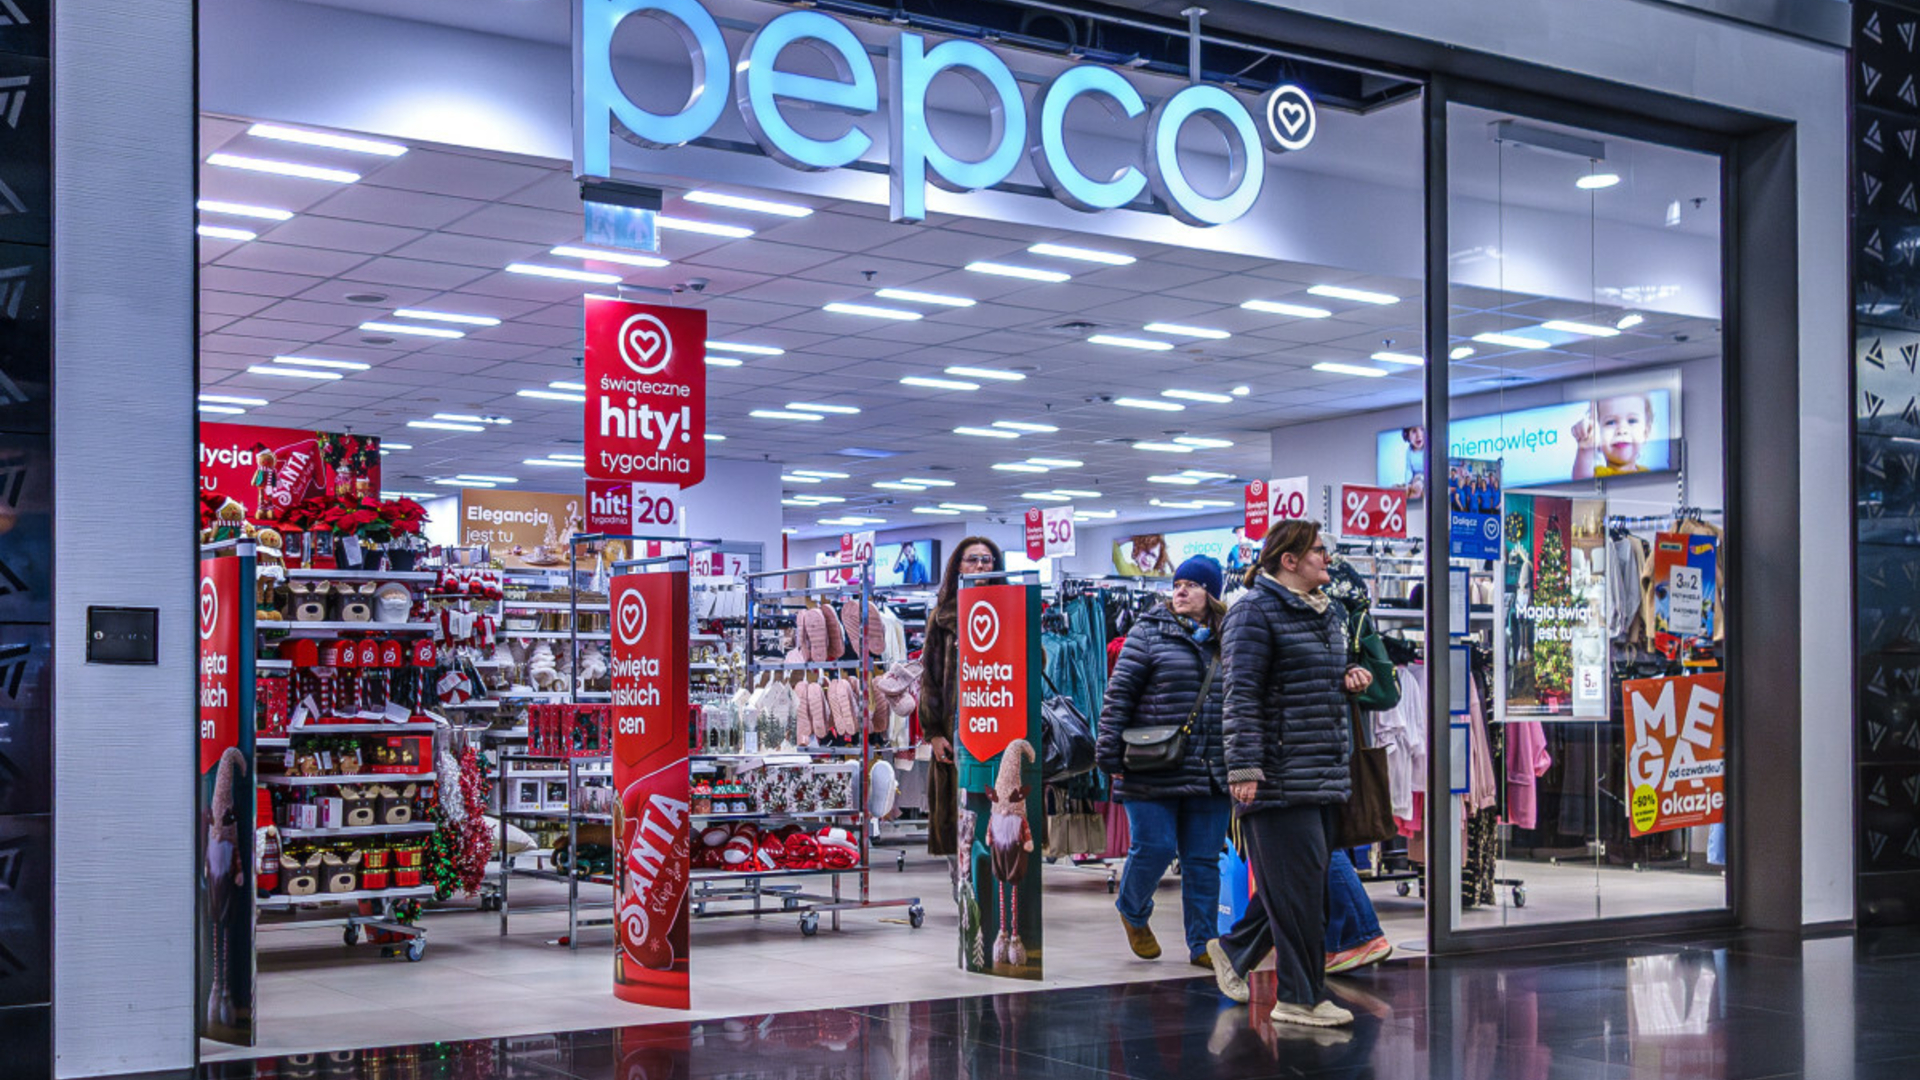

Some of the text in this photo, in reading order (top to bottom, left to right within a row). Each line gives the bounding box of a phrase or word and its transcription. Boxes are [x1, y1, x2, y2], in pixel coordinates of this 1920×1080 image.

[573, 0, 1265, 227] pepco
[600, 373, 690, 397] świąteczne
[600, 395, 691, 451] hity!
[1450, 428, 1558, 458] niemowlęta
[600, 450, 690, 474] tygodnia
[271, 451, 310, 506] SANTA
[467, 506, 549, 526] Elegancja
[591, 491, 628, 516] hit!
[638, 496, 674, 525] 20
[1273, 491, 1305, 520] 40
[591, 515, 628, 525] tygodnia
[1047, 518, 1071, 544] 30
[465, 527, 514, 543] jest tu
[1516, 603, 1594, 624] Magia świąt
[1533, 624, 1573, 643] jest tu
[612, 650, 660, 682] Święta
[962, 655, 1013, 686] Święta
[961, 685, 1015, 708] niskich
[618, 716, 645, 735] cen
[969, 716, 999, 734] cen
[1669, 767, 1680, 780] od
[1661, 786, 1724, 816] okazje
[621, 794, 689, 947] SANTA
